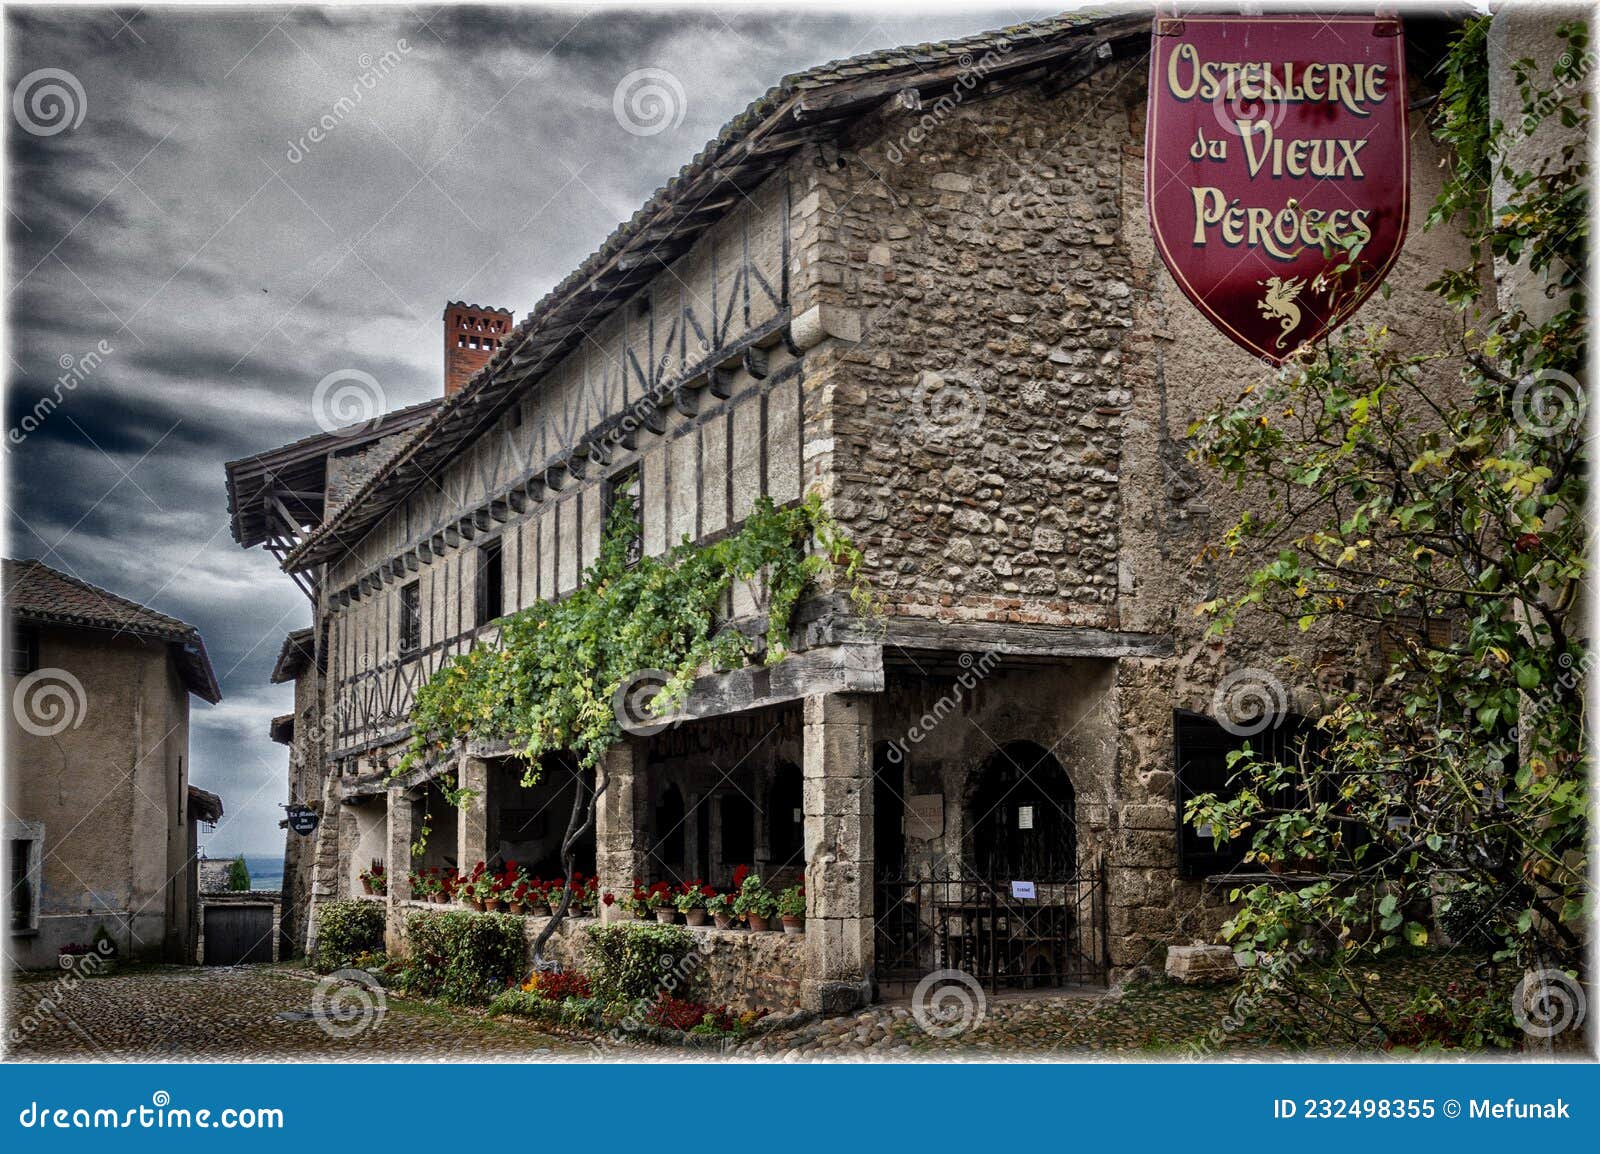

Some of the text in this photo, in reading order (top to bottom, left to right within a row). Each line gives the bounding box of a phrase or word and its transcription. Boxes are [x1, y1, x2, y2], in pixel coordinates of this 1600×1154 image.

[1167, 42, 1389, 115] OSTELLERIE
[1190, 118, 1368, 178] du VIEUX
